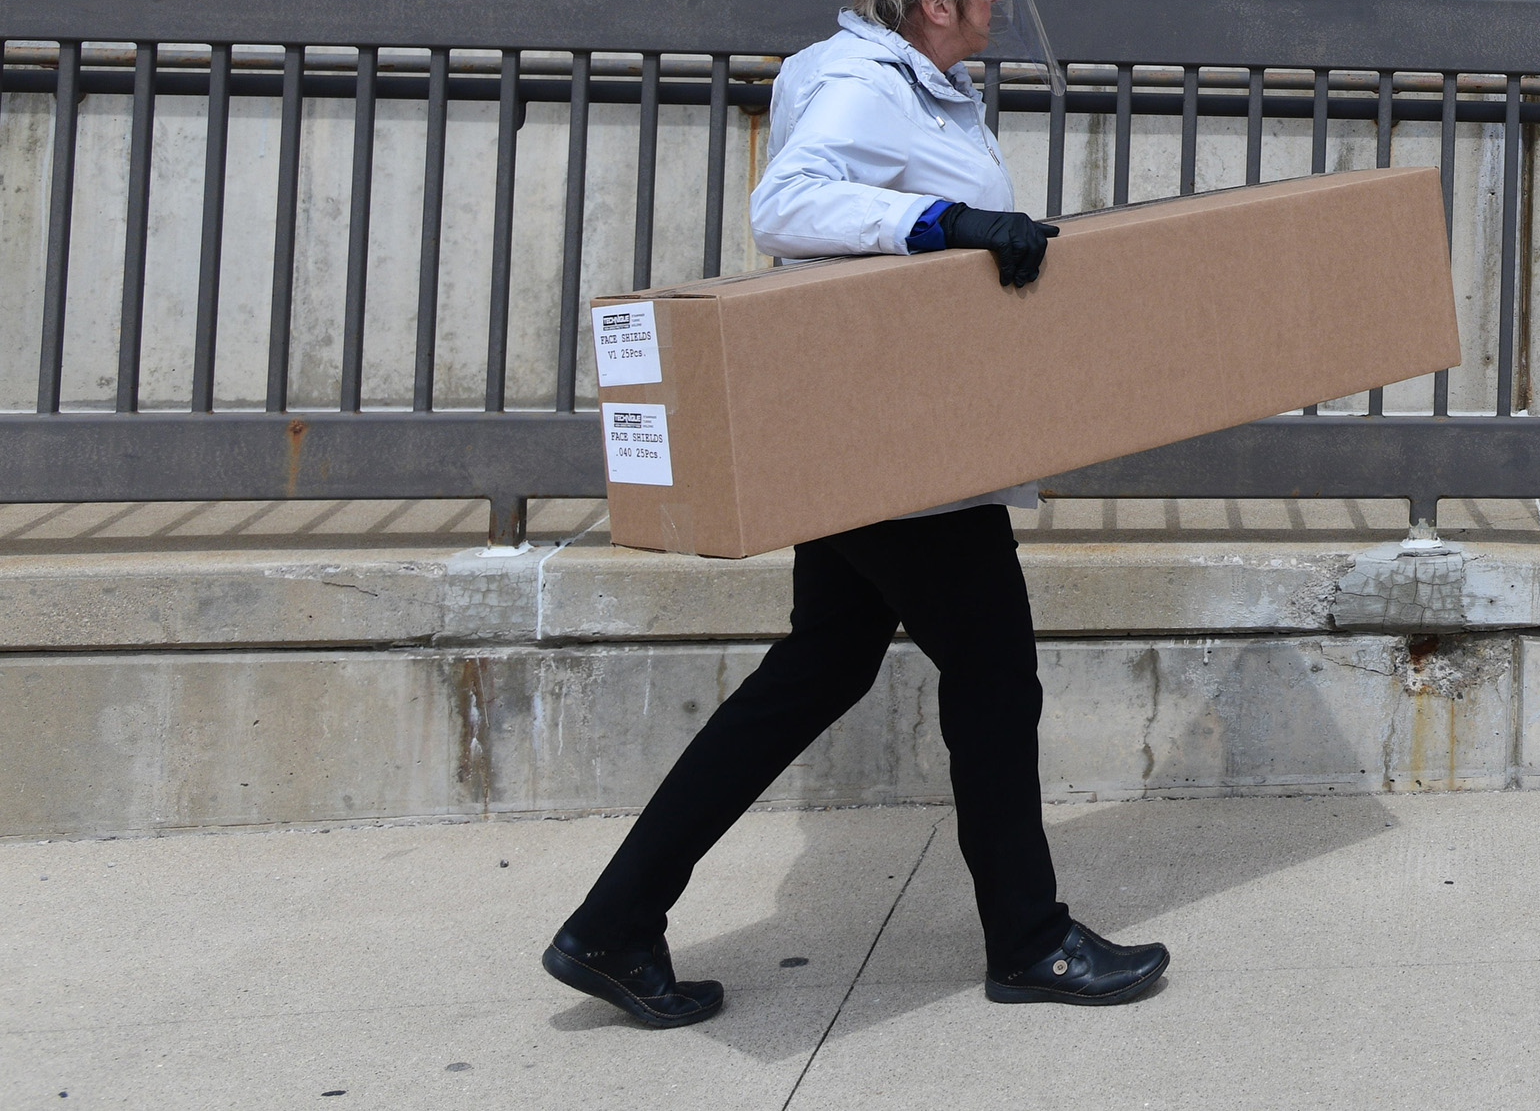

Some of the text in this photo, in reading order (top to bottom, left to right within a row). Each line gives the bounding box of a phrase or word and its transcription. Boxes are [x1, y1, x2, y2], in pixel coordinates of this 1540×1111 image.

[600, 331, 652, 345] FACE SHIELDS
[607, 348, 647, 359] V1 25Pcs.
[610, 431, 663, 443] FACE SHIELDS
[615, 447, 662, 459] .040 25Pcs.
